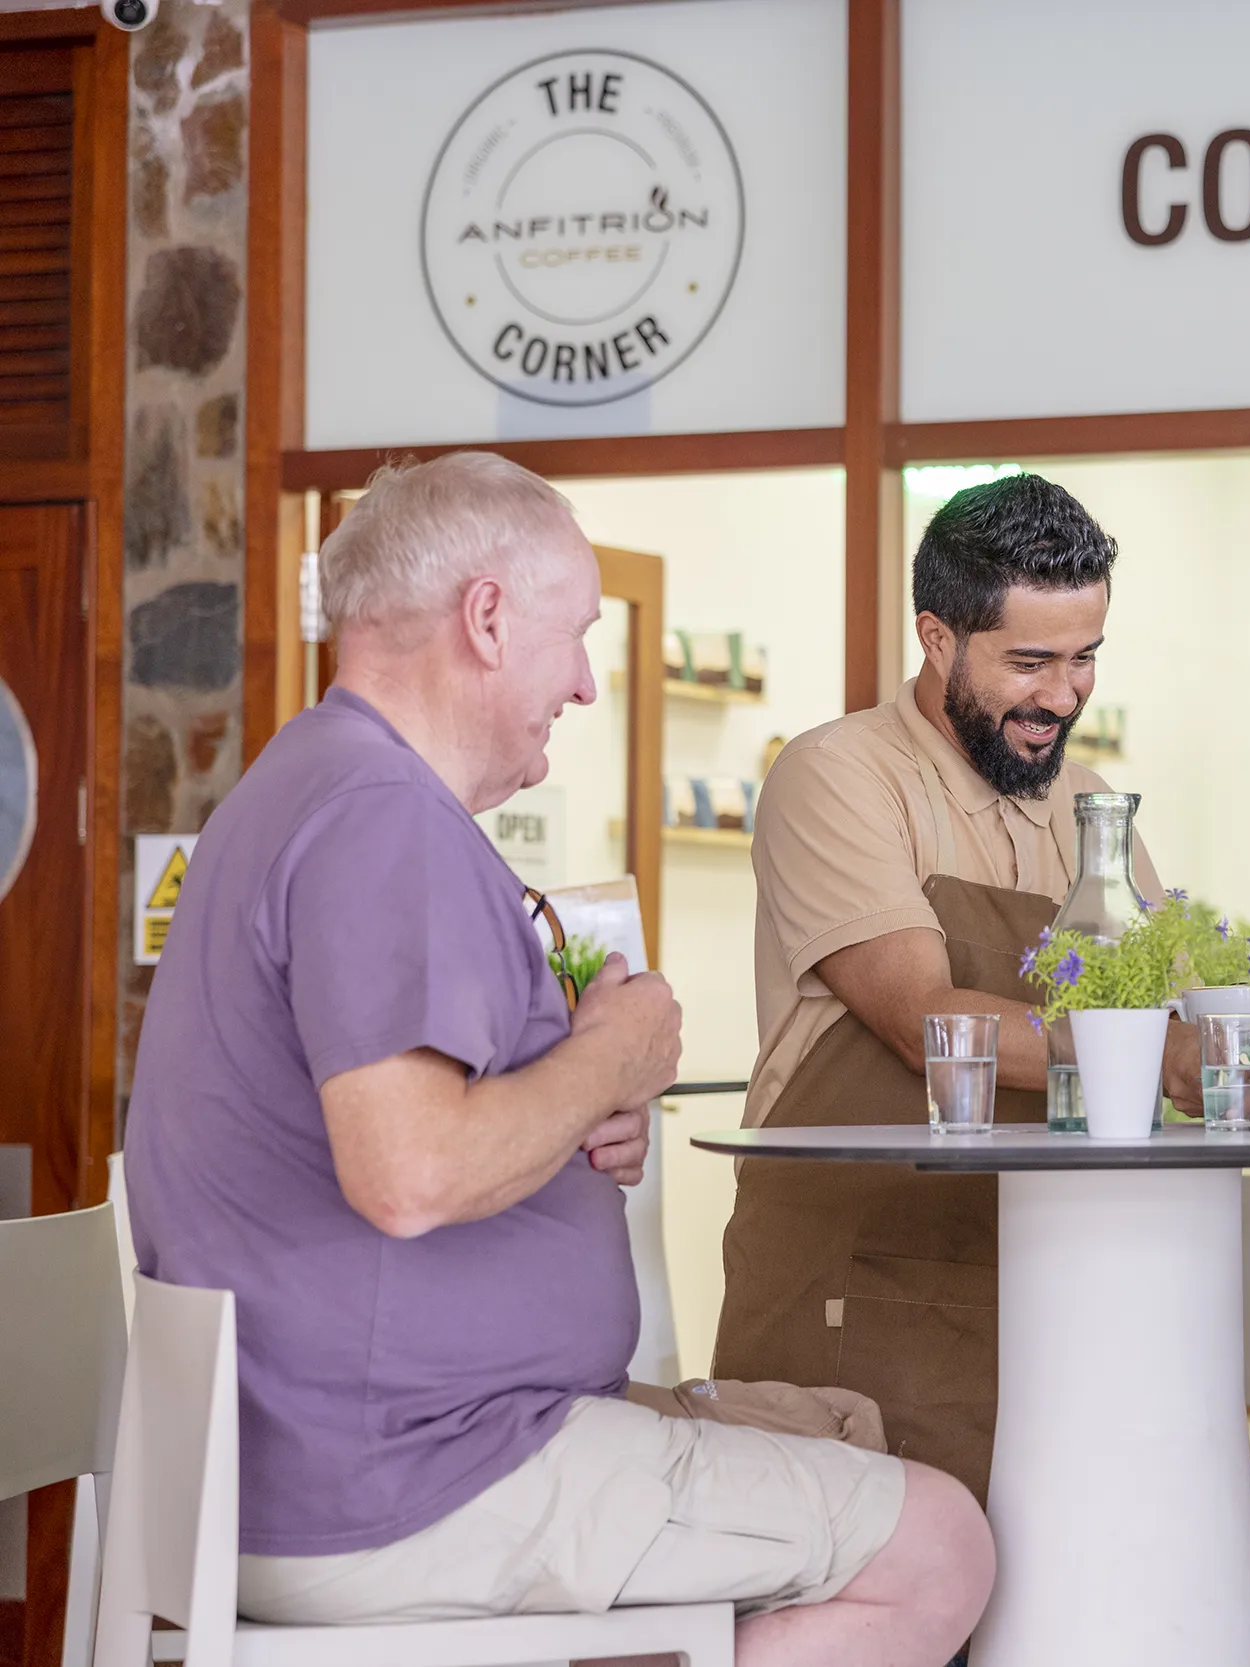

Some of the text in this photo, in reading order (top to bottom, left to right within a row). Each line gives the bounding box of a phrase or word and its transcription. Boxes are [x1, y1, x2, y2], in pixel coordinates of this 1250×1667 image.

[536, 71, 623, 117] THE
[518, 245, 643, 269] COFFEE
[492, 315, 671, 384] CORNER
[496, 812, 547, 843] OPEN
